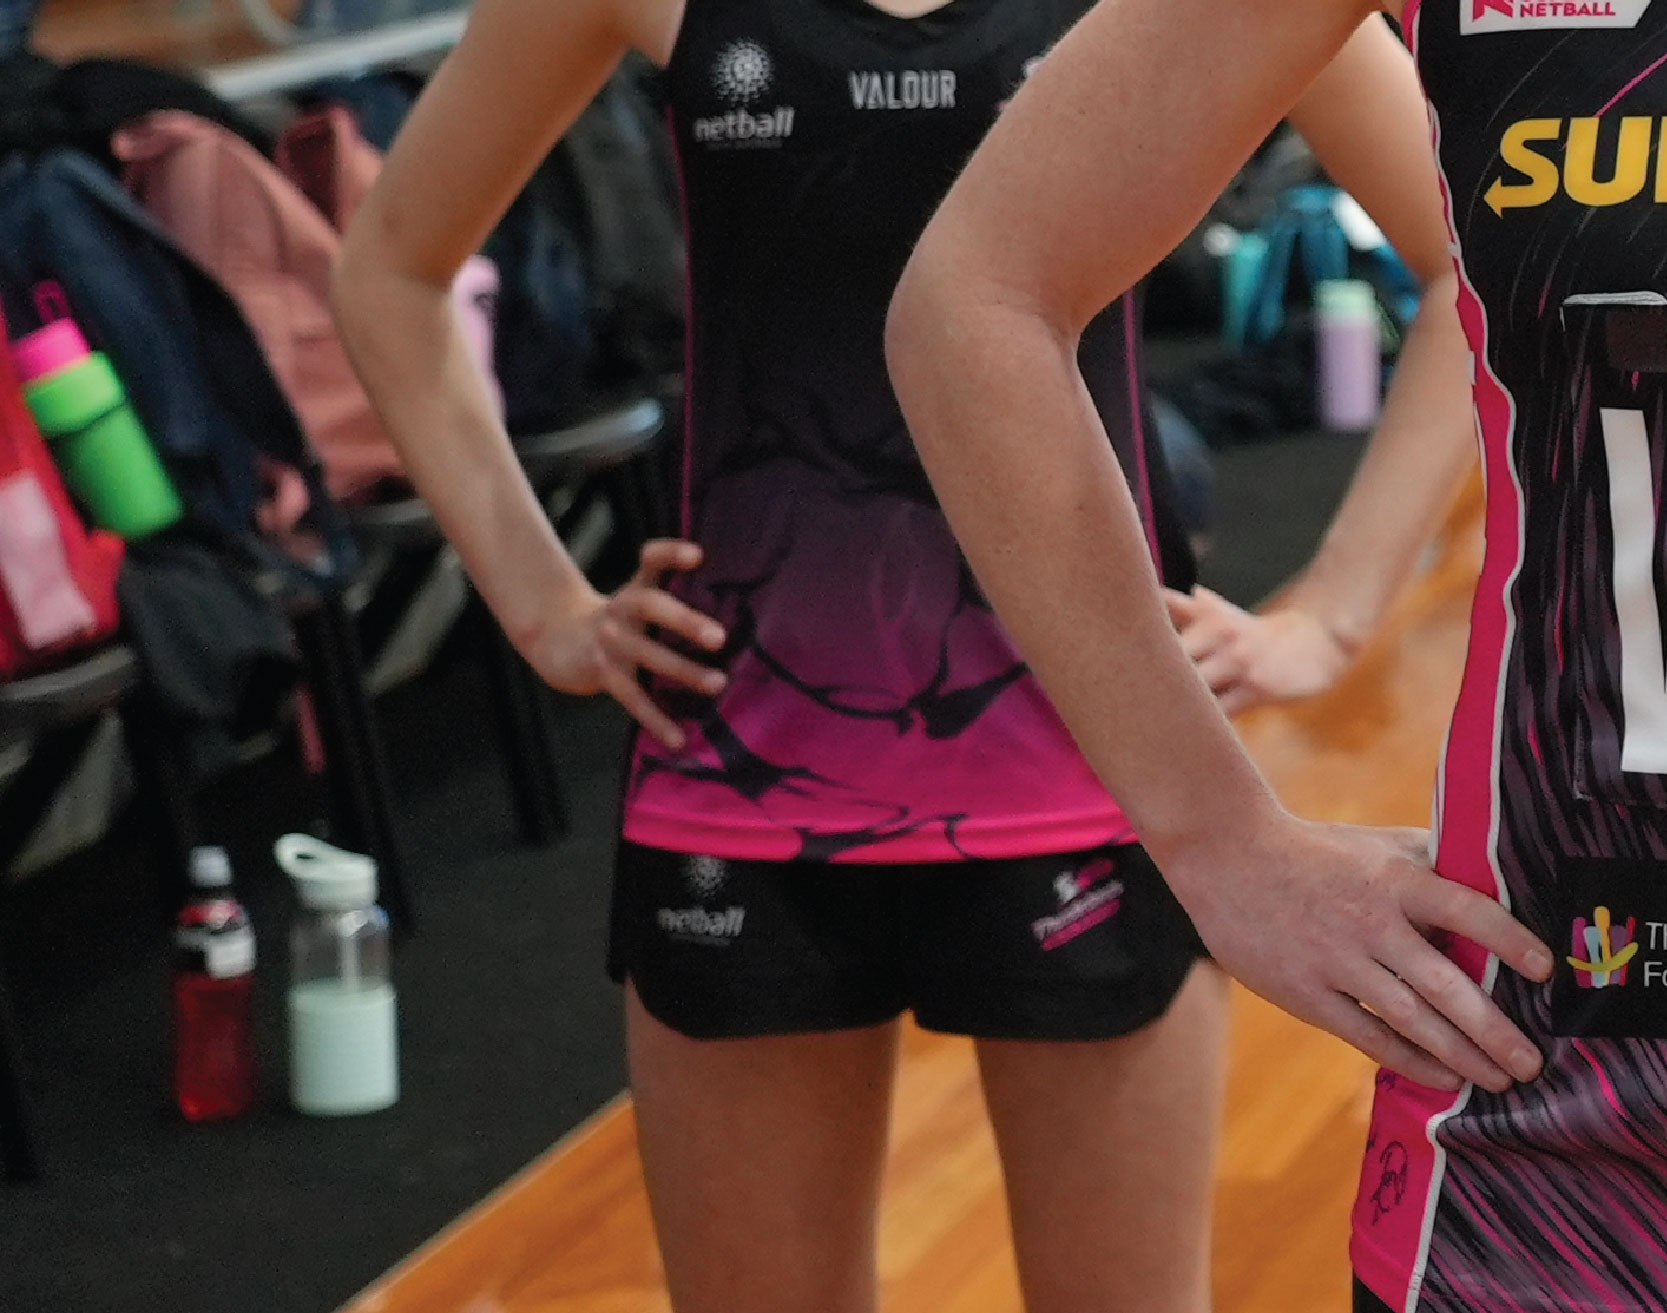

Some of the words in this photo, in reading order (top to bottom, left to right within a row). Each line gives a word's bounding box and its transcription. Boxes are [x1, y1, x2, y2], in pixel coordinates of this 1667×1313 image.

[1519, 1, 1617, 18] NETBALL
[848, 69, 956, 110] VALOUR
[695, 106, 795, 142] netball
